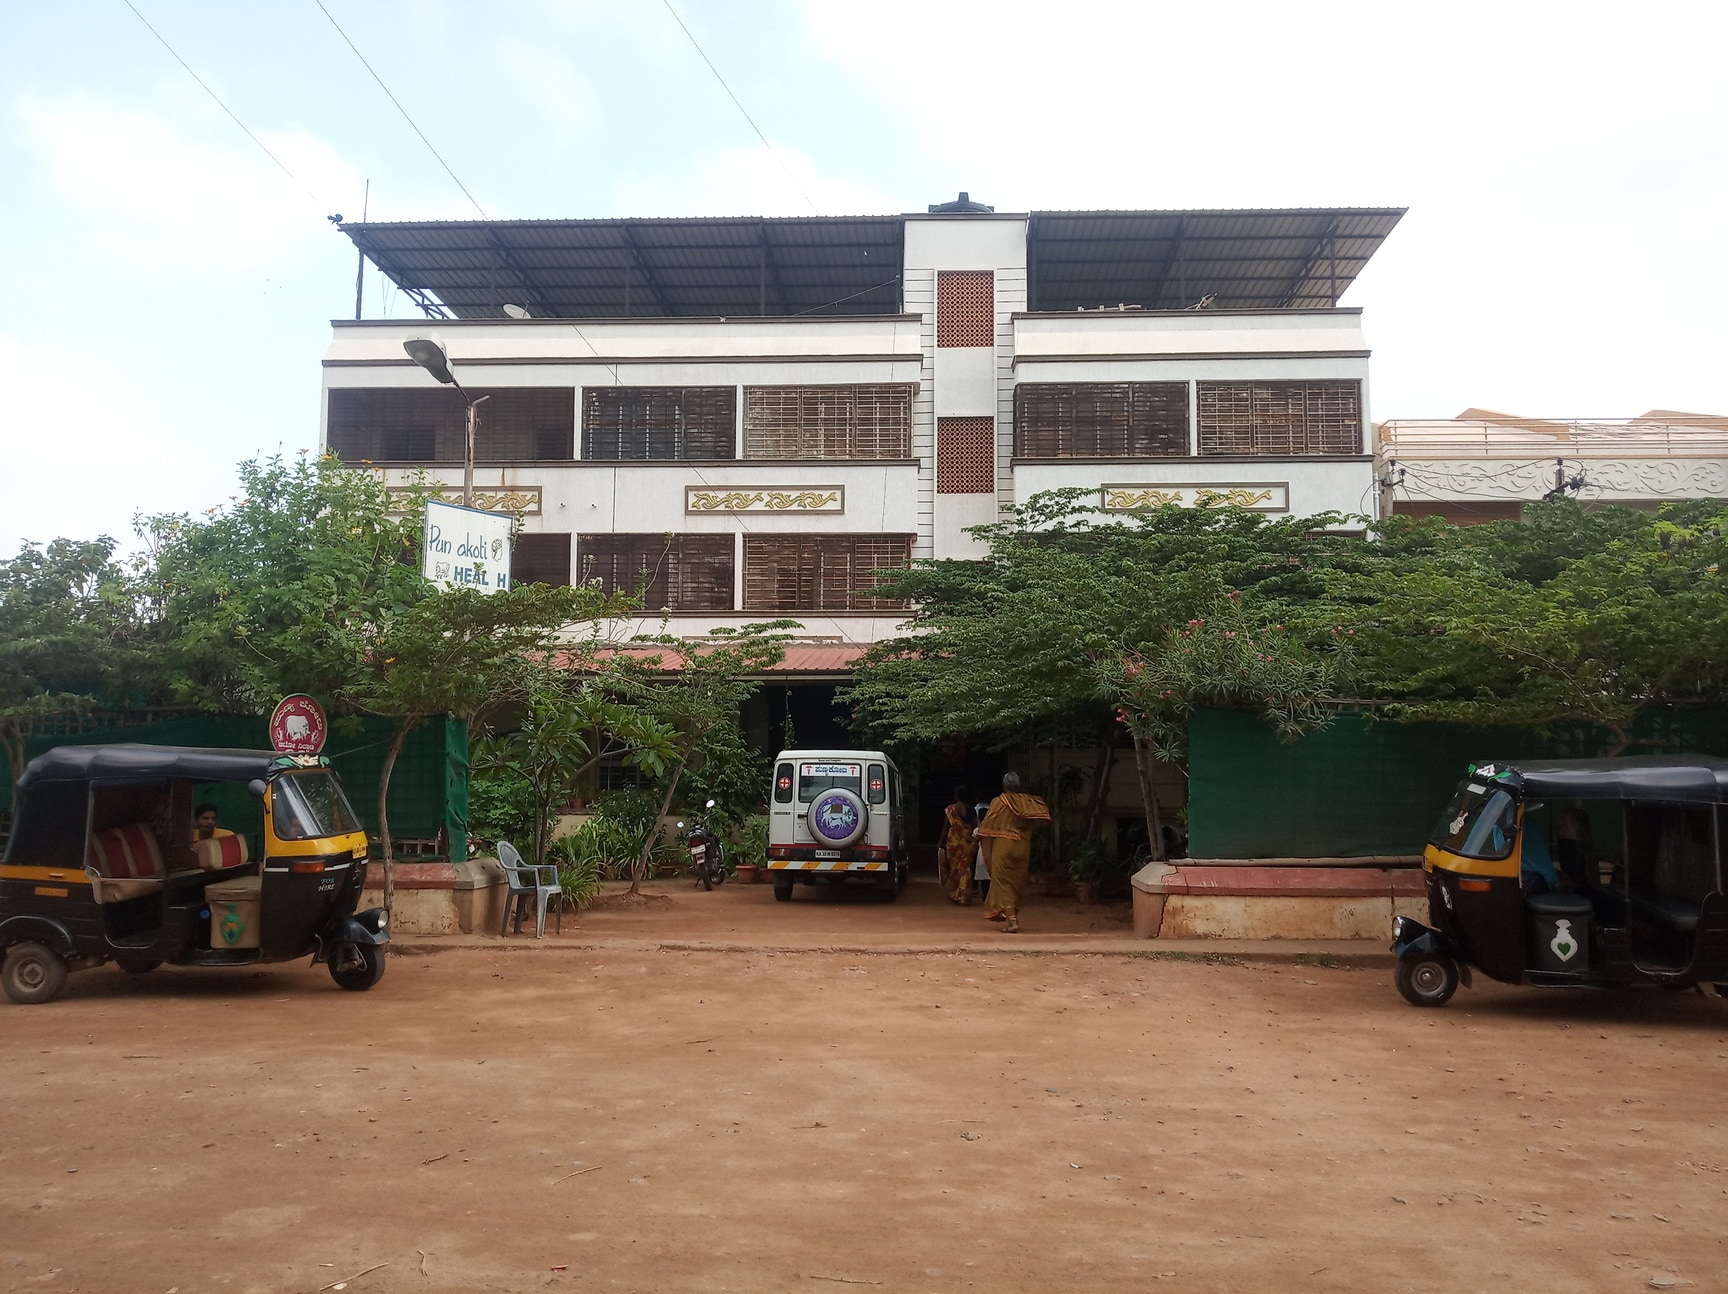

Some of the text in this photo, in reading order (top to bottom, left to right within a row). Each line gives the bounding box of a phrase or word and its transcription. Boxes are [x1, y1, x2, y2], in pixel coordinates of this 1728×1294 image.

[457, 532, 488, 560] akoti
[454, 566, 489, 586] HEAL
[317, 883, 336, 892] HIRE
[320, 877, 335, 885] FOR
